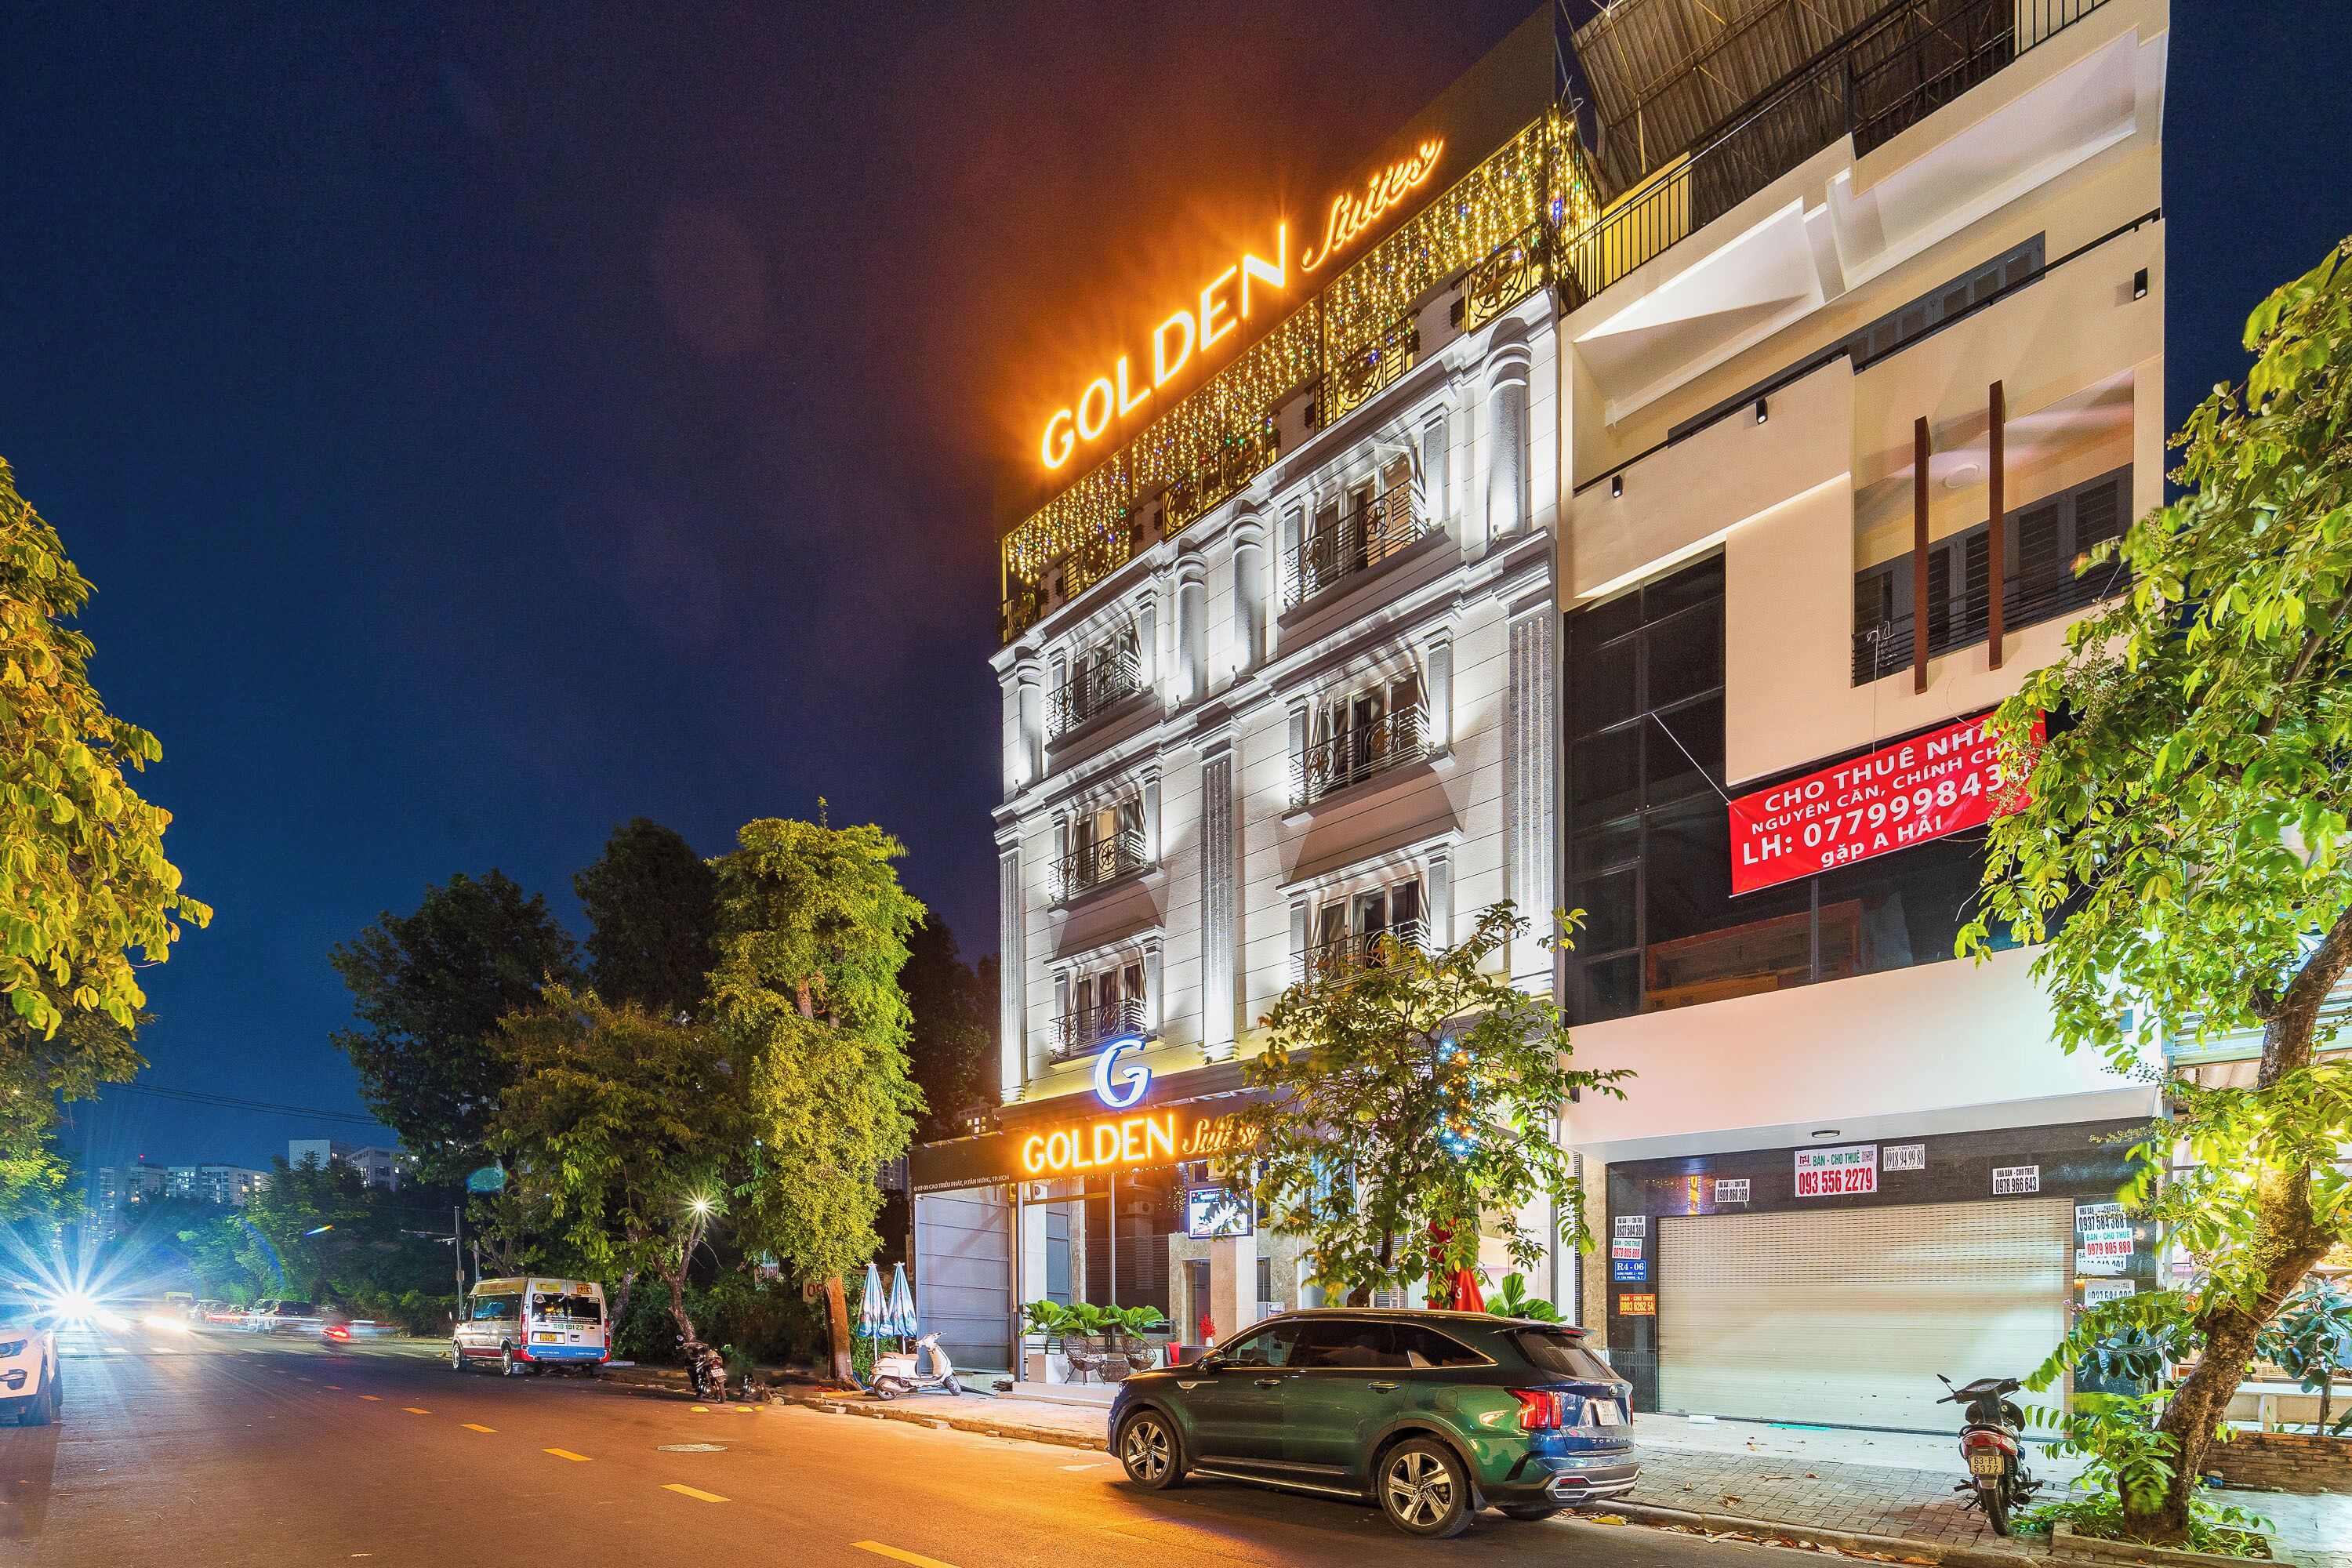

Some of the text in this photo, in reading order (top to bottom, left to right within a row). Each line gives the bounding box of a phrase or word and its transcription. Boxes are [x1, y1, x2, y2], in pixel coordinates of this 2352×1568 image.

[1042, 140, 1443, 469] GOLDEN Suites
[1751, 803, 1830, 834] NGUYÊN
[1893, 757, 1962, 789] CHÍNH
[1970, 741, 2016, 764] CH
[1765, 781, 1824, 812] CHO
[1833, 746, 1915, 788] THUÊ
[1743, 833, 1793, 866] LH:
[1820, 815, 1943, 868] gặp A HẢI
[1094, 1039, 1152, 1108] G
[1023, 1114, 1174, 1173] GOLDEN
[1813, 1152, 1825, 1167] BÁN
[1831, 1153, 1843, 1166] CHO
[1845, 1149, 1860, 1163] THUÊ
[1885, 1149, 1924, 1167] 0918 94 99 88
[1798, 1167, 1873, 1195] 093 556 2279
[1995, 1176, 2037, 1193] 0978 966 643
[2078, 1216, 2095, 1231] 0937
[2087, 1240, 2132, 1255] 0979 805 888
[2103, 1232, 2114, 1240] CHO
[1620, 1301, 1654, 1311] 0903 6262 54
[1974, 1465, 1998, 1473] 5372
